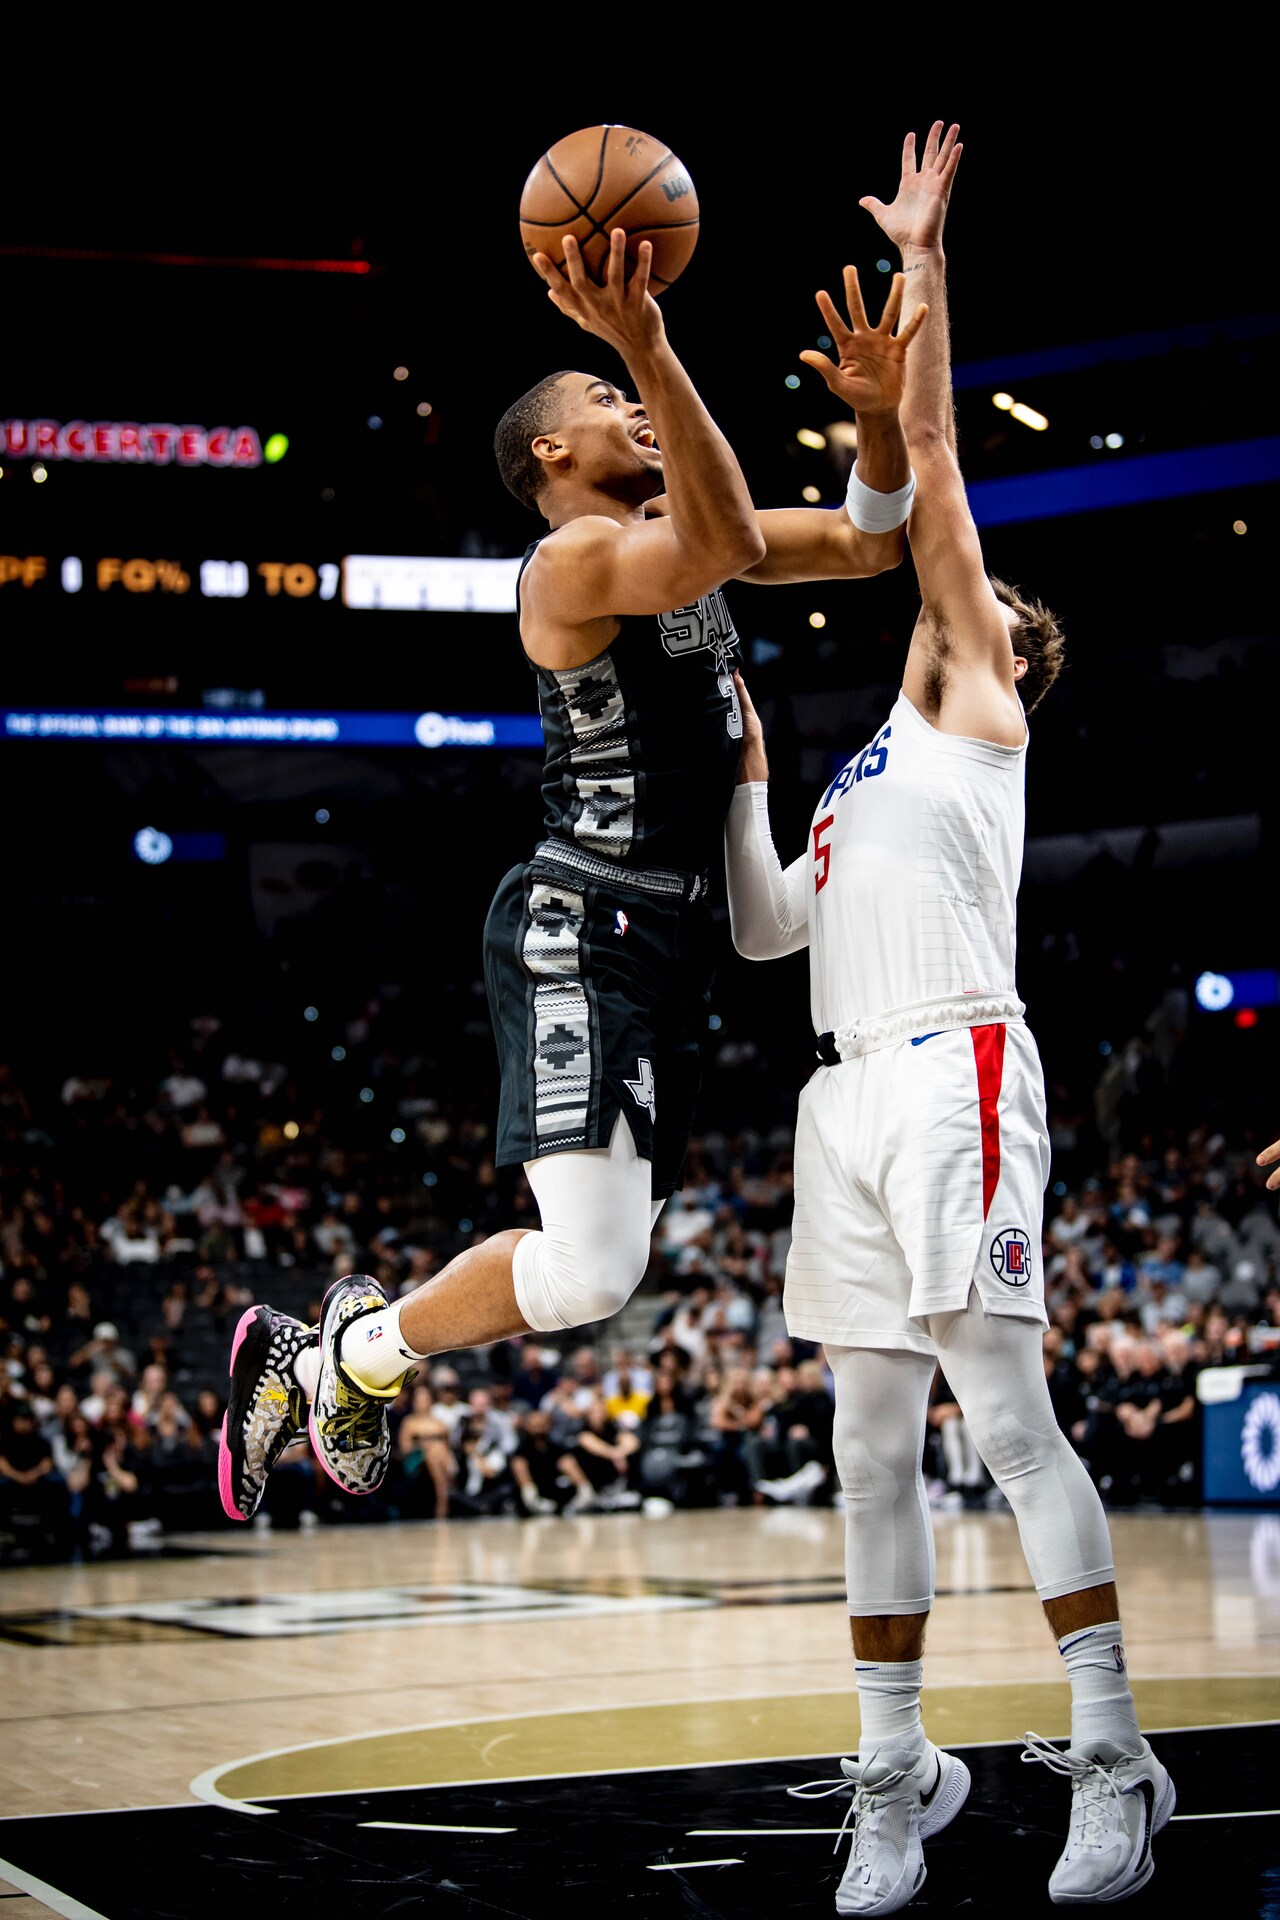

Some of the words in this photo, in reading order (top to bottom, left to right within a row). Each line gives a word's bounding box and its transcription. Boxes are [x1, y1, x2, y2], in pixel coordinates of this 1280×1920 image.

[0, 418, 262, 468] URGERTECA
[256, 562, 317, 598] TO
[812, 814, 834, 896] 5
